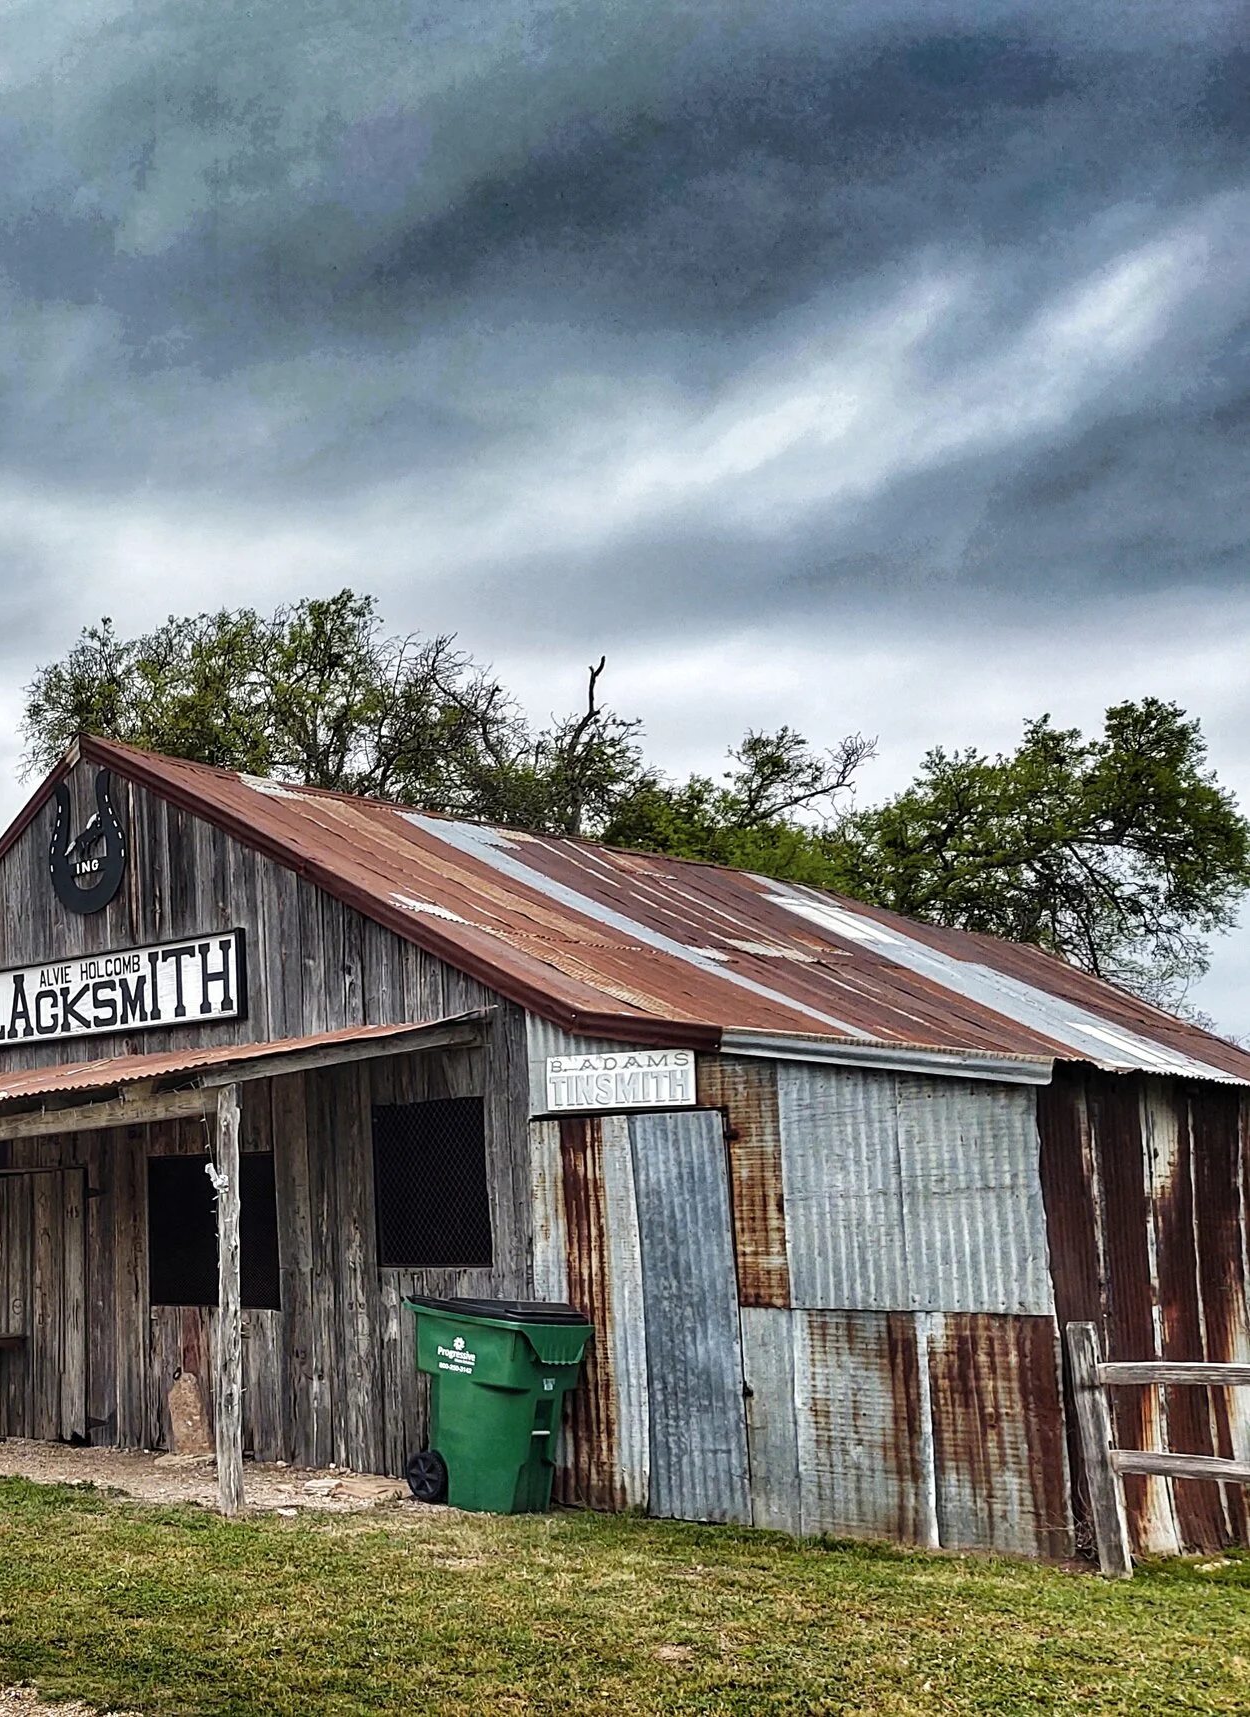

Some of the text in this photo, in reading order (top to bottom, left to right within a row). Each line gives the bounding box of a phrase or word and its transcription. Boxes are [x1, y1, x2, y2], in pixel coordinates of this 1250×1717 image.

[76, 859, 100, 875] ING
[39, 954, 141, 988] ALVIE HOLCOMB
[579, 1052, 690, 1071] ADAMS
[549, 1069, 691, 1106] TINSMITH
